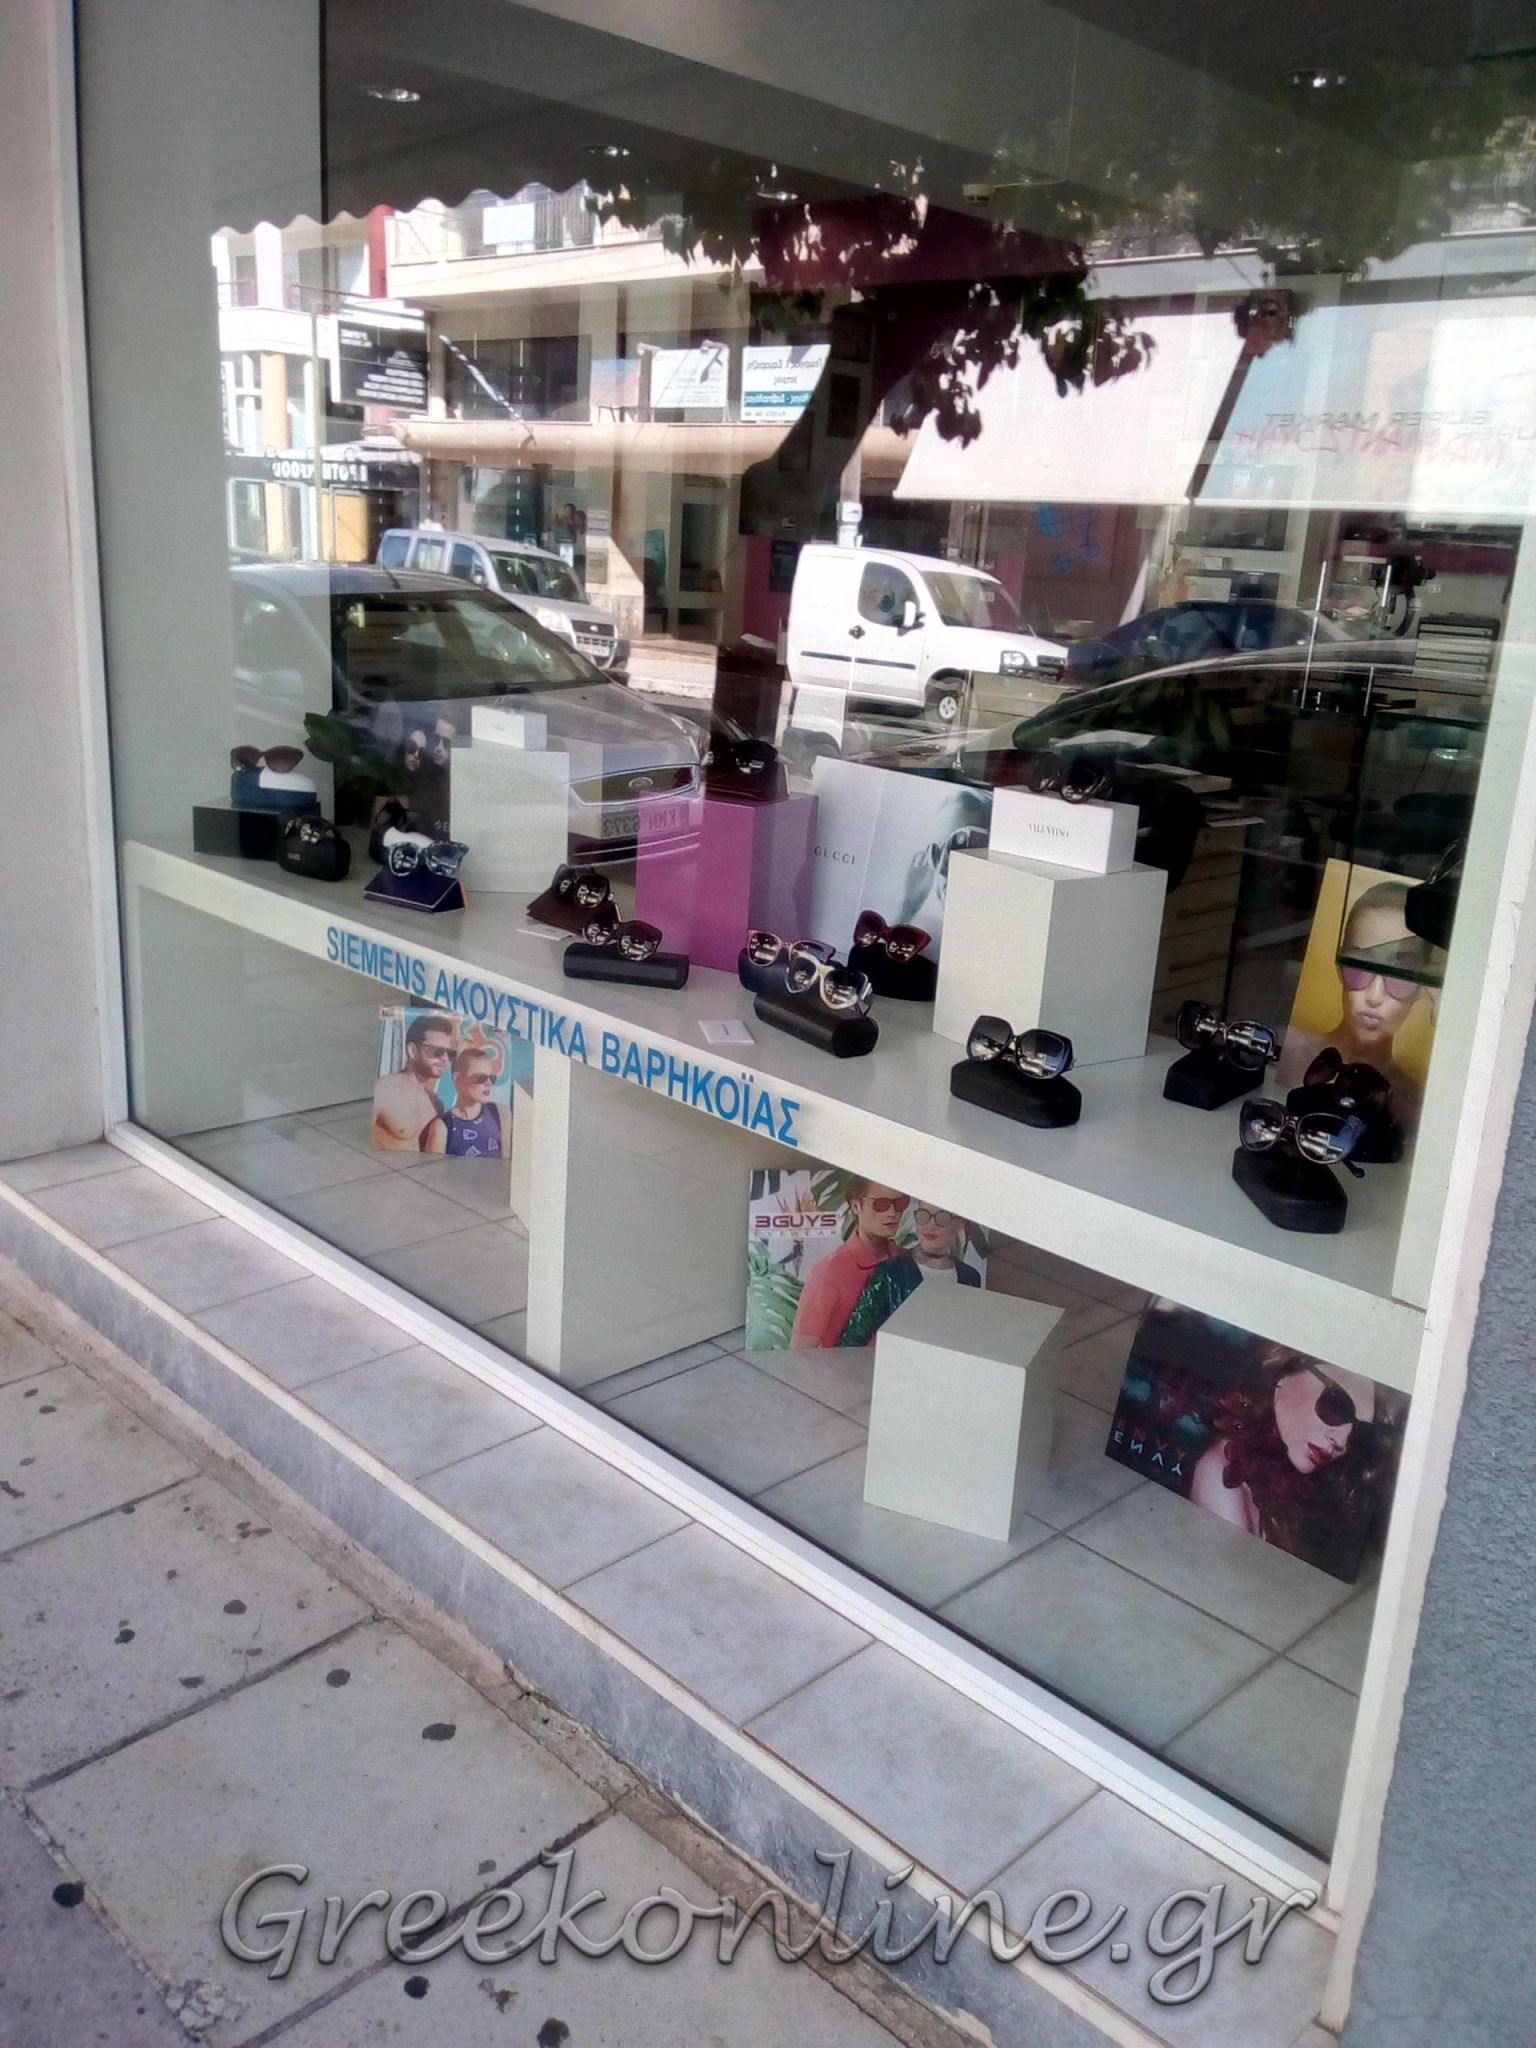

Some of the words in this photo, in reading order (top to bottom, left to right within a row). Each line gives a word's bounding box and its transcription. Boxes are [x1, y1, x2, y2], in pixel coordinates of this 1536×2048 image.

[814, 845, 856, 865] GUCCI
[326, 925, 427, 998] SIEMENS
[434, 974, 588, 1064] ΑΚΟΥΣΤΙΚΑ
[602, 1032, 801, 1147] ΒΑΡΗΚΟΪΑΣ
[755, 1213, 838, 1229] 3GUYS
[754, 1229, 838, 1238] EYEWEAR
